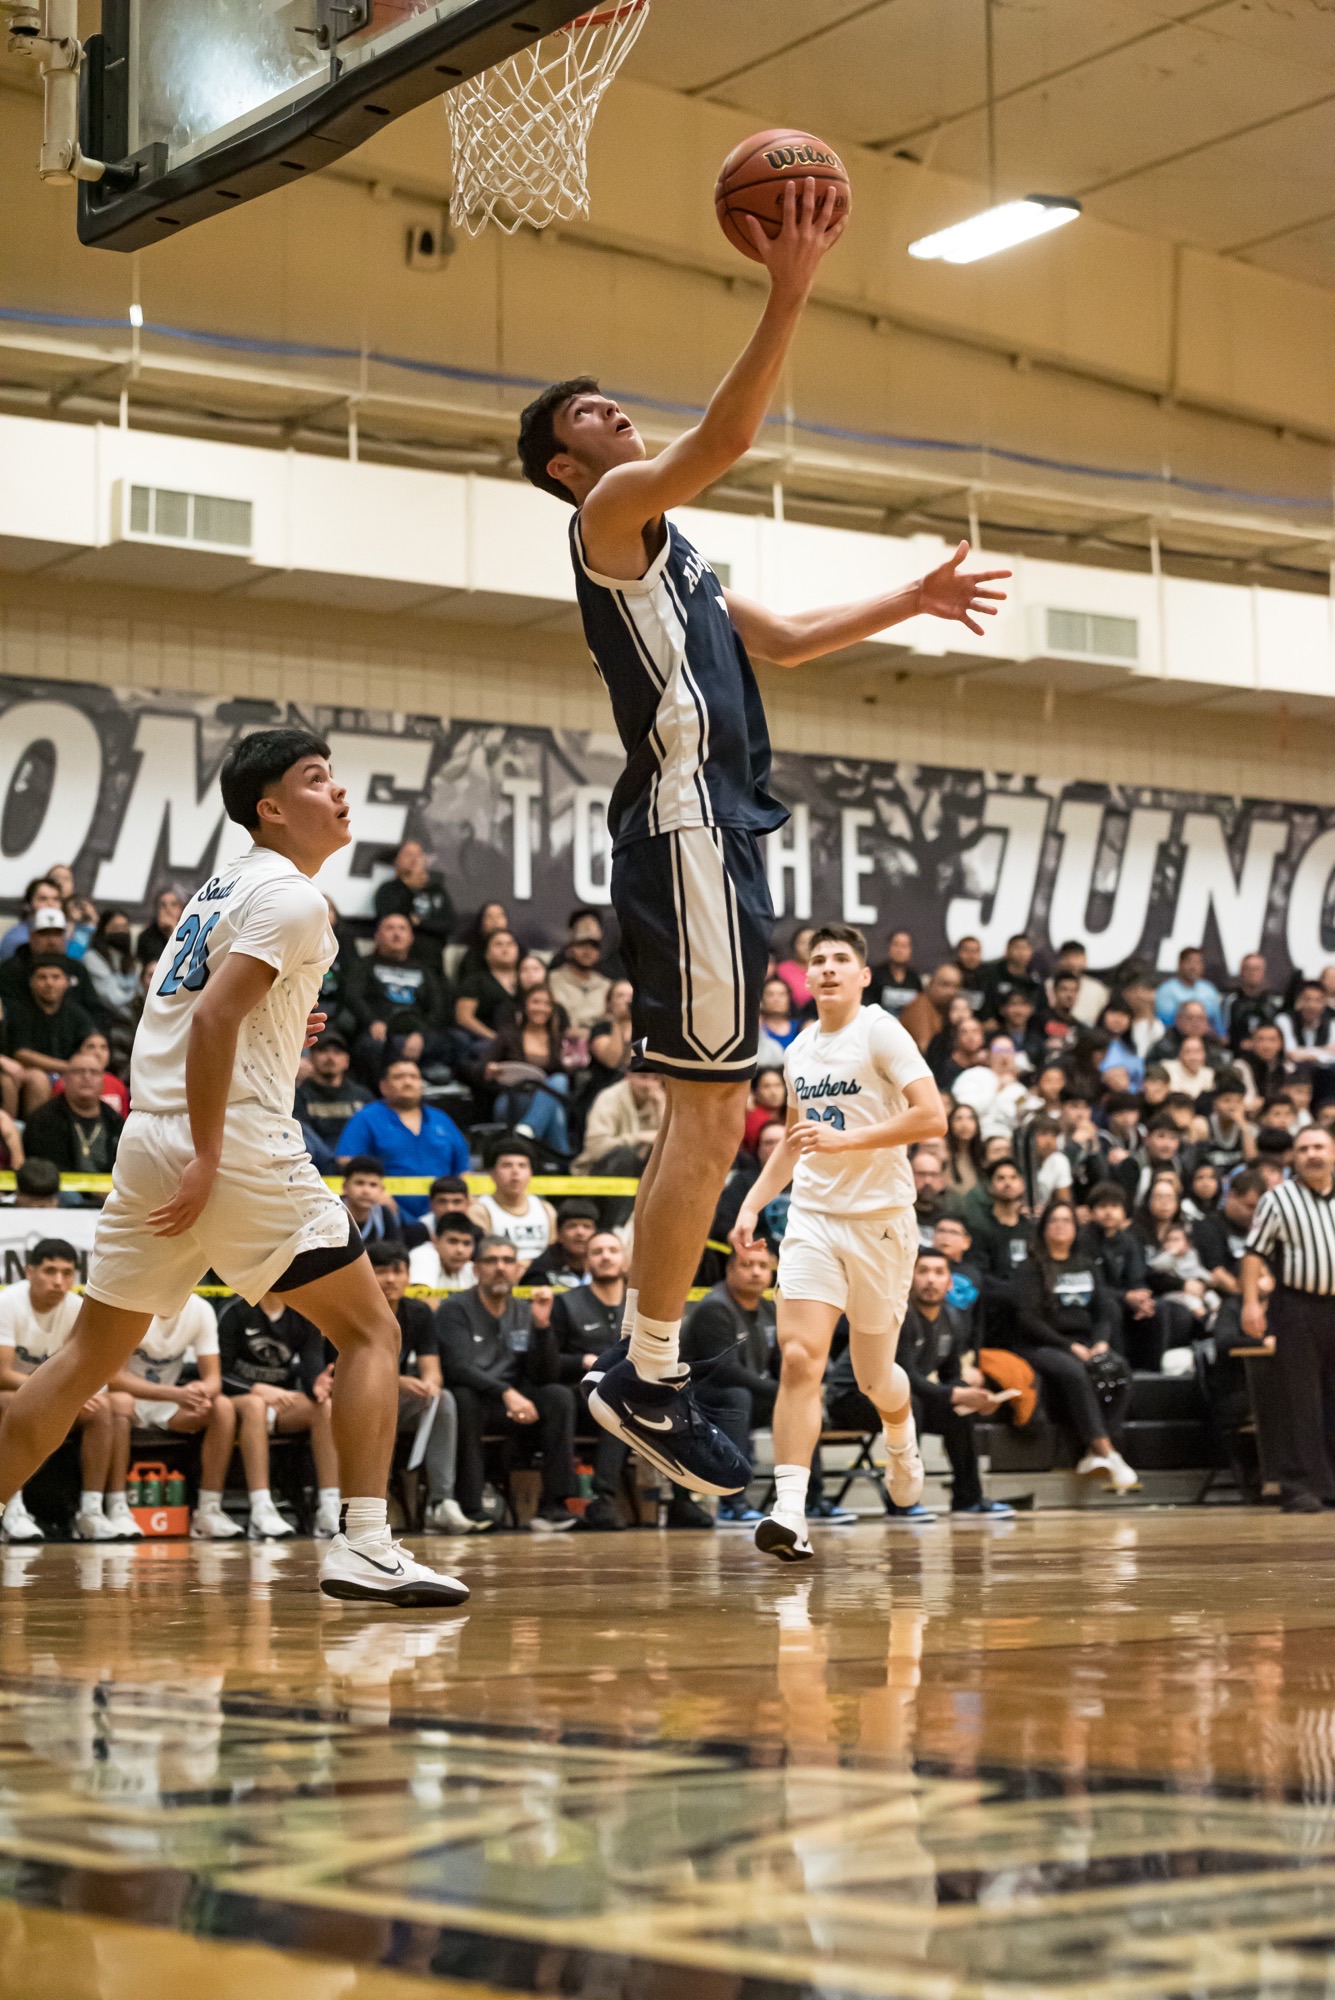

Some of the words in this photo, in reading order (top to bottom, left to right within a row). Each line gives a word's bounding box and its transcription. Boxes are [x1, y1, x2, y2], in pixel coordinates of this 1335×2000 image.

[767, 803, 878, 924] HE
[794, 1073, 862, 1100] Panthers
[150, 1511, 168, 1533] G
